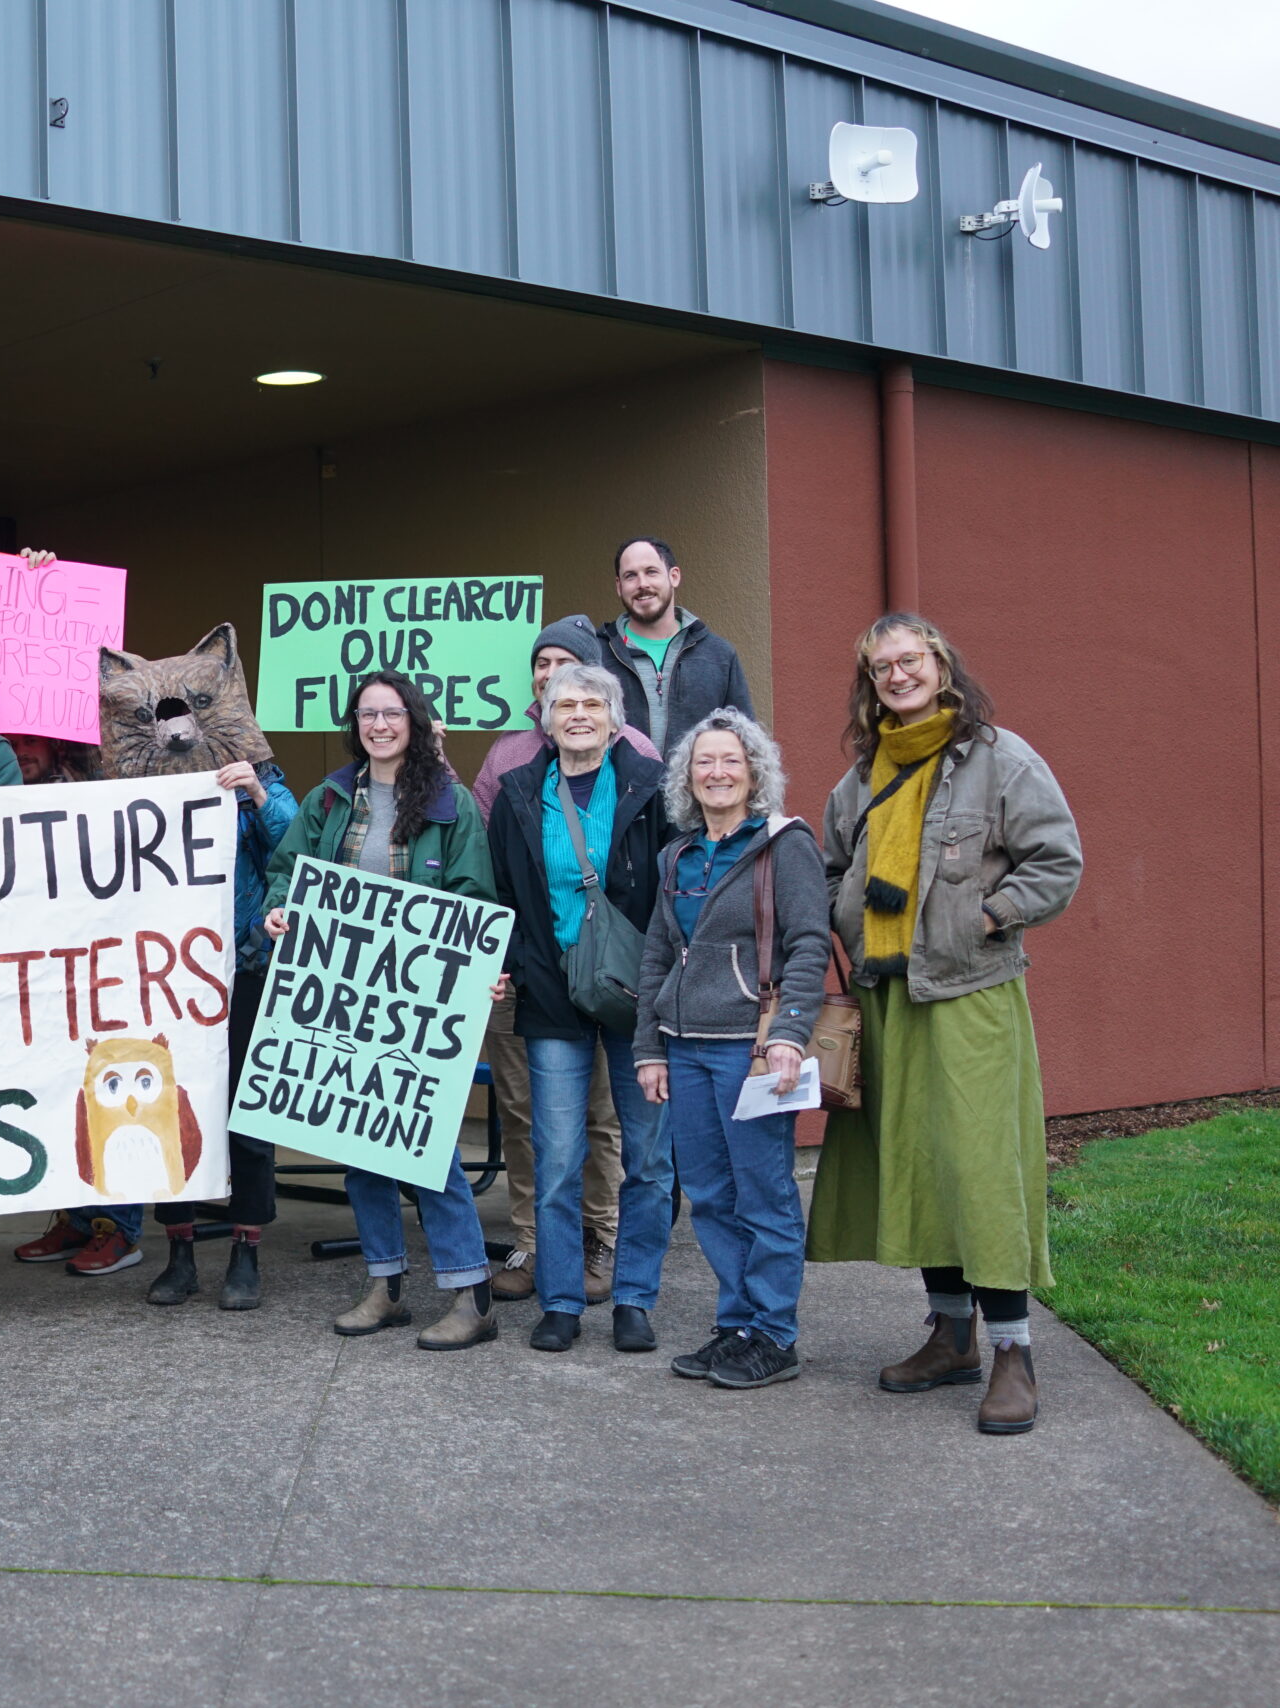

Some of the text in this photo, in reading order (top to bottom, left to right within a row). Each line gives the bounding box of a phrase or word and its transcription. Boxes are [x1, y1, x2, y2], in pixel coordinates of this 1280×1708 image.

[1, 610, 120, 645] POLLUTION
[269, 580, 543, 638] DONT CLEARCUT
[340, 628, 433, 674] OUR
[295, 674, 512, 729] FURES
[291, 862, 509, 955] PROTECTING
[277, 910, 472, 1005] INTACT
[264, 969, 466, 1060] FORESTS
[251, 1038, 440, 1113] CLIMATE
[294, 1025, 421, 1072] IS A
[238, 1074, 433, 1158] SOLUTION!
